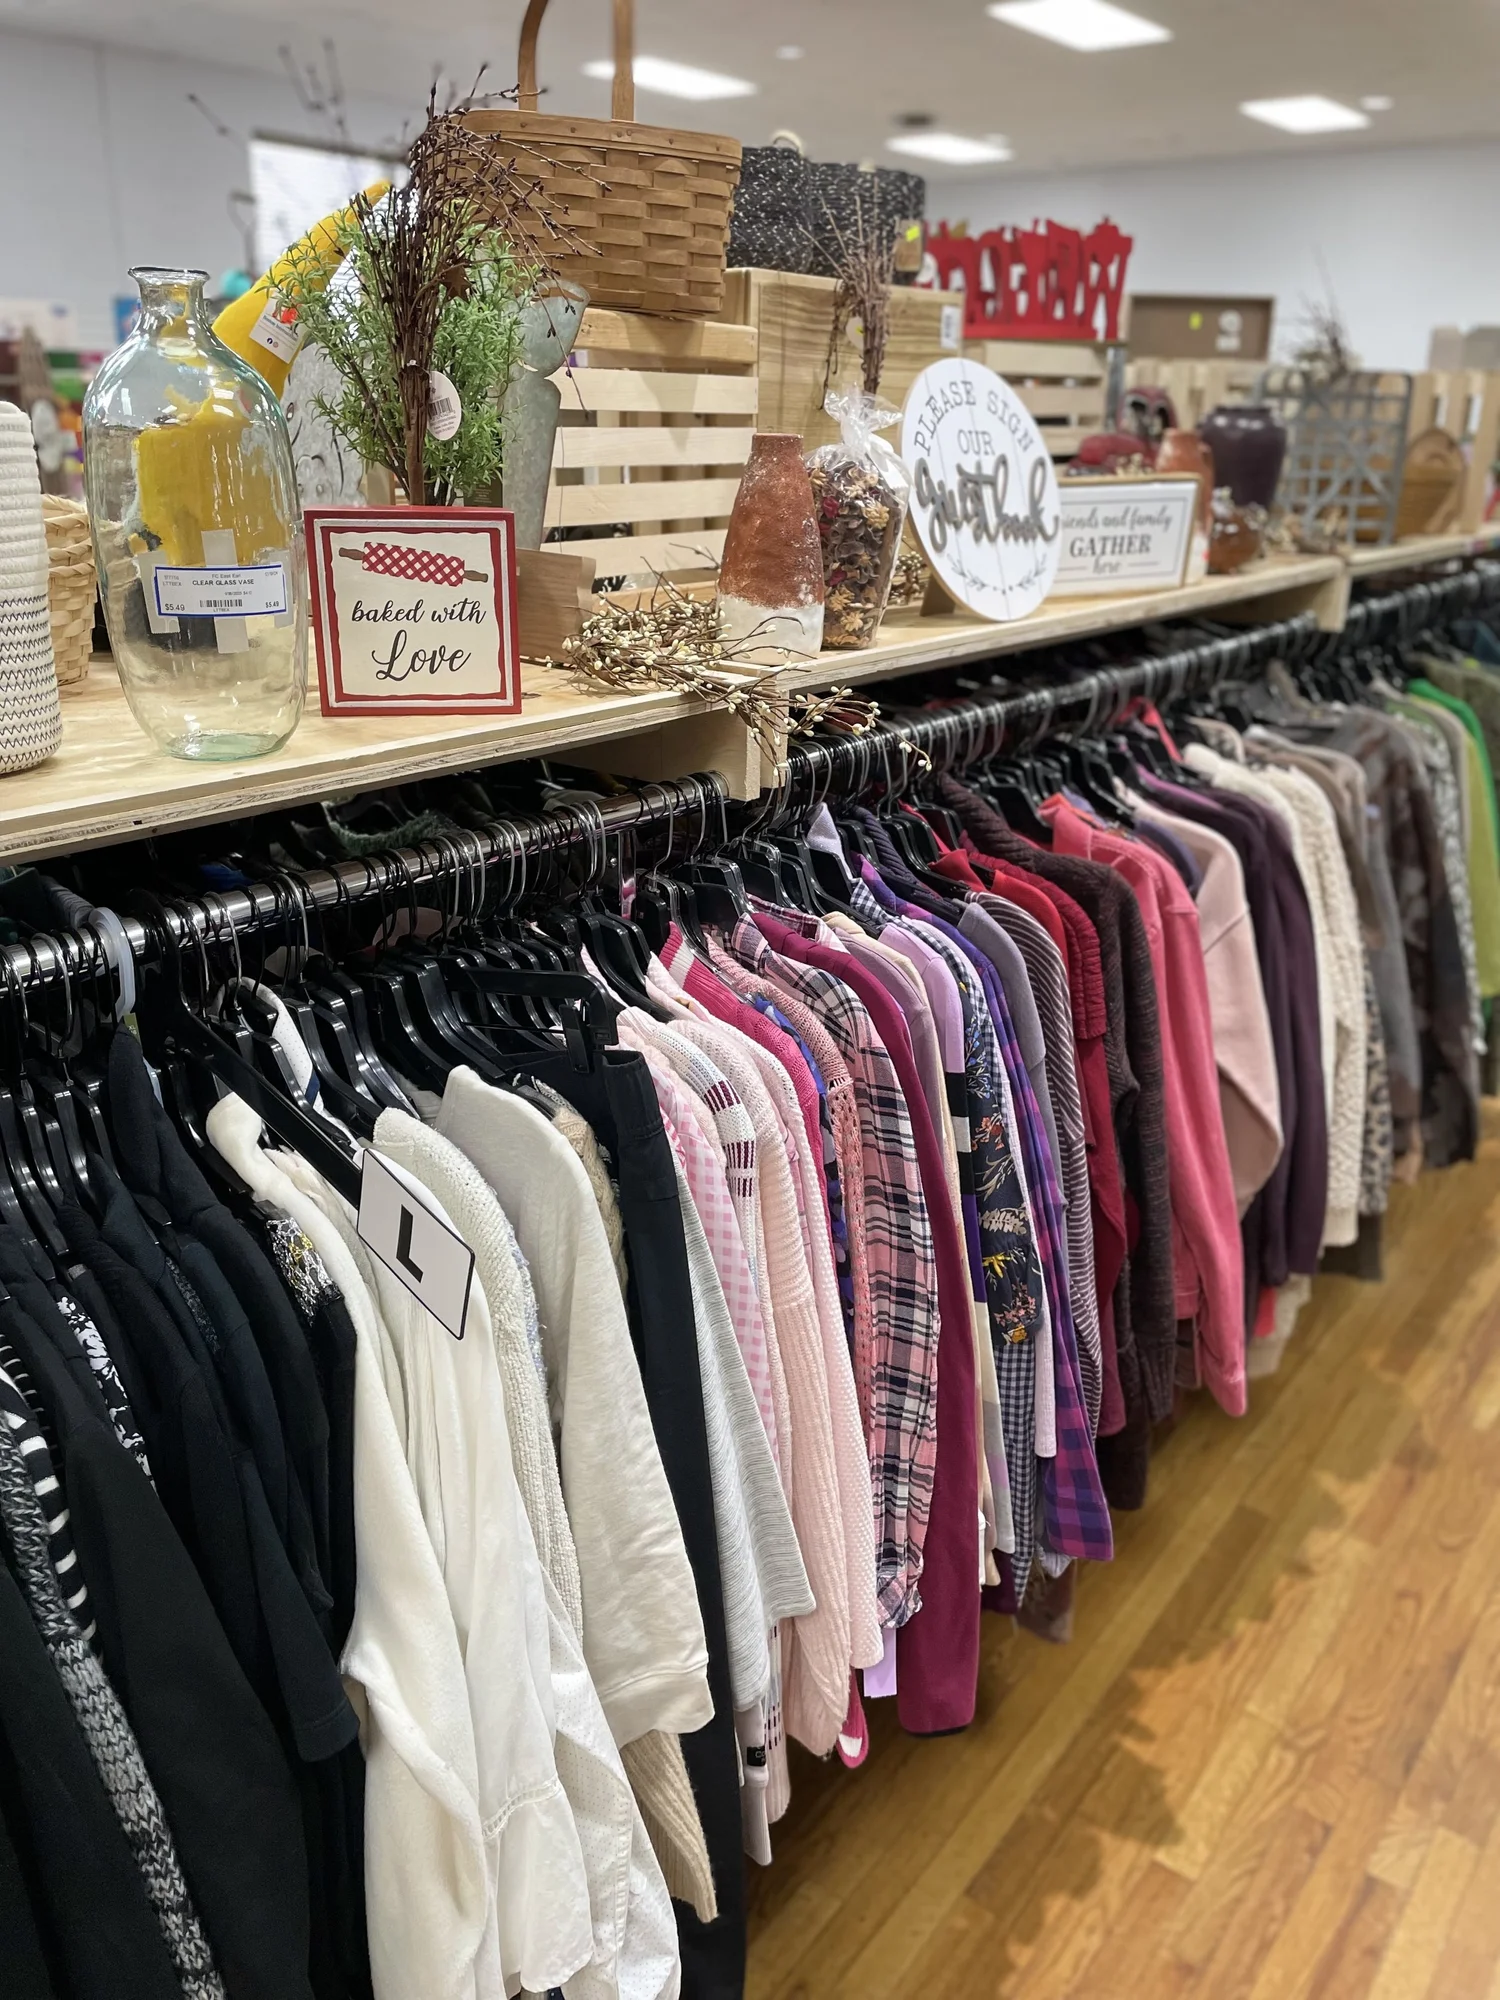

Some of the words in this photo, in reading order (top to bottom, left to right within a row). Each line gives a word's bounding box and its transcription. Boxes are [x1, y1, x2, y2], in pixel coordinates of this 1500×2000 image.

[914, 380, 976, 456] PLEASE
[987, 390, 1034, 453] SIGN
[957, 429, 995, 456] OUR
[1102, 505, 1130, 528] and
[1129, 505, 1172, 533] family
[1069, 533, 1152, 558] GATHER
[1092, 558, 1121, 574] here
[165, 603, 185, 611] $5.49
[351, 599, 425, 623] baked
[431, 597, 486, 624] with
[371, 629, 472, 681] Love
[396, 1204, 424, 1283] L
